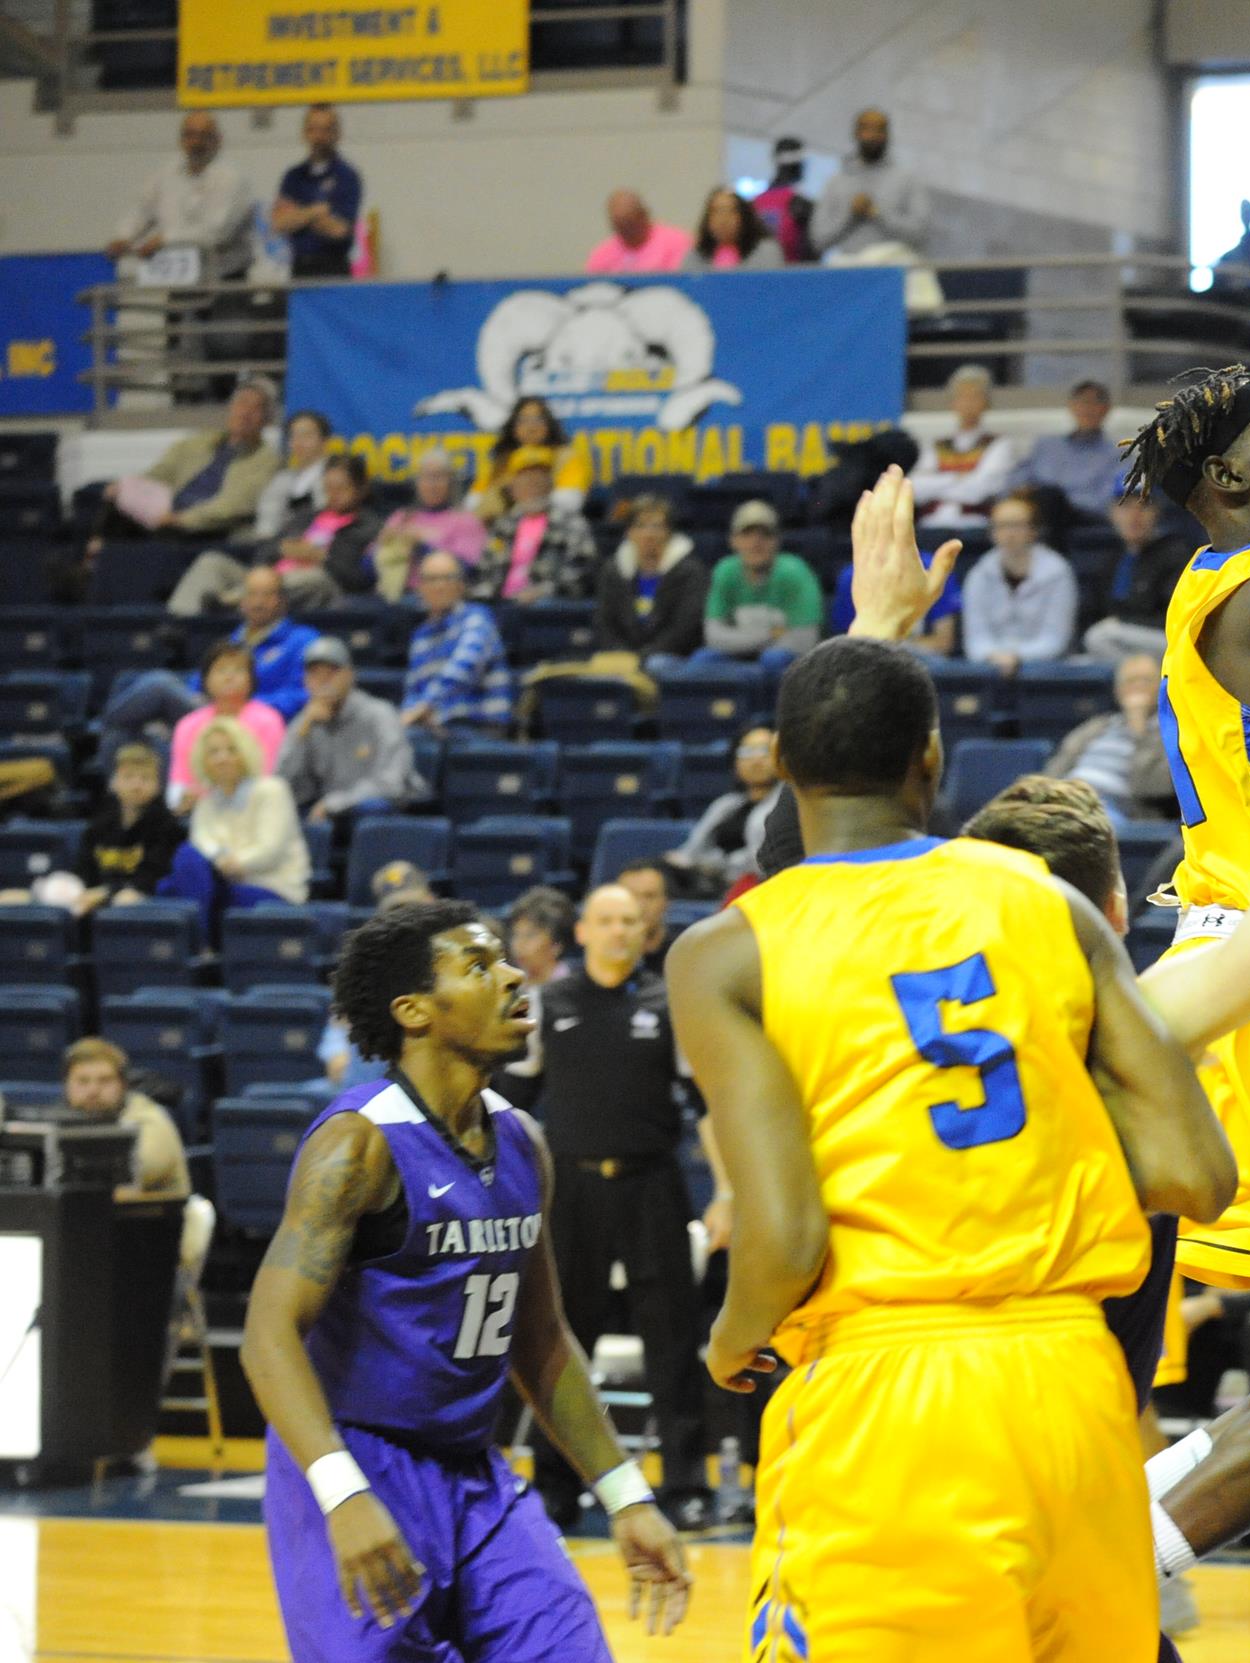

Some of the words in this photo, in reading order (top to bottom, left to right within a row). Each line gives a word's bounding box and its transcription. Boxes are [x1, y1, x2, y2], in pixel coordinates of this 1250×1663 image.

[267, 7, 417, 41] INVESTMENT
[186, 58, 338, 92] RETIREMENT
[477, 50, 524, 81] LLC
[570, 425, 749, 485] ATIONAL
[765, 420, 892, 479] BA
[890, 951, 1027, 1150] 5
[426, 1212, 543, 1256] TARLETO
[453, 1272, 520, 1359] 12
